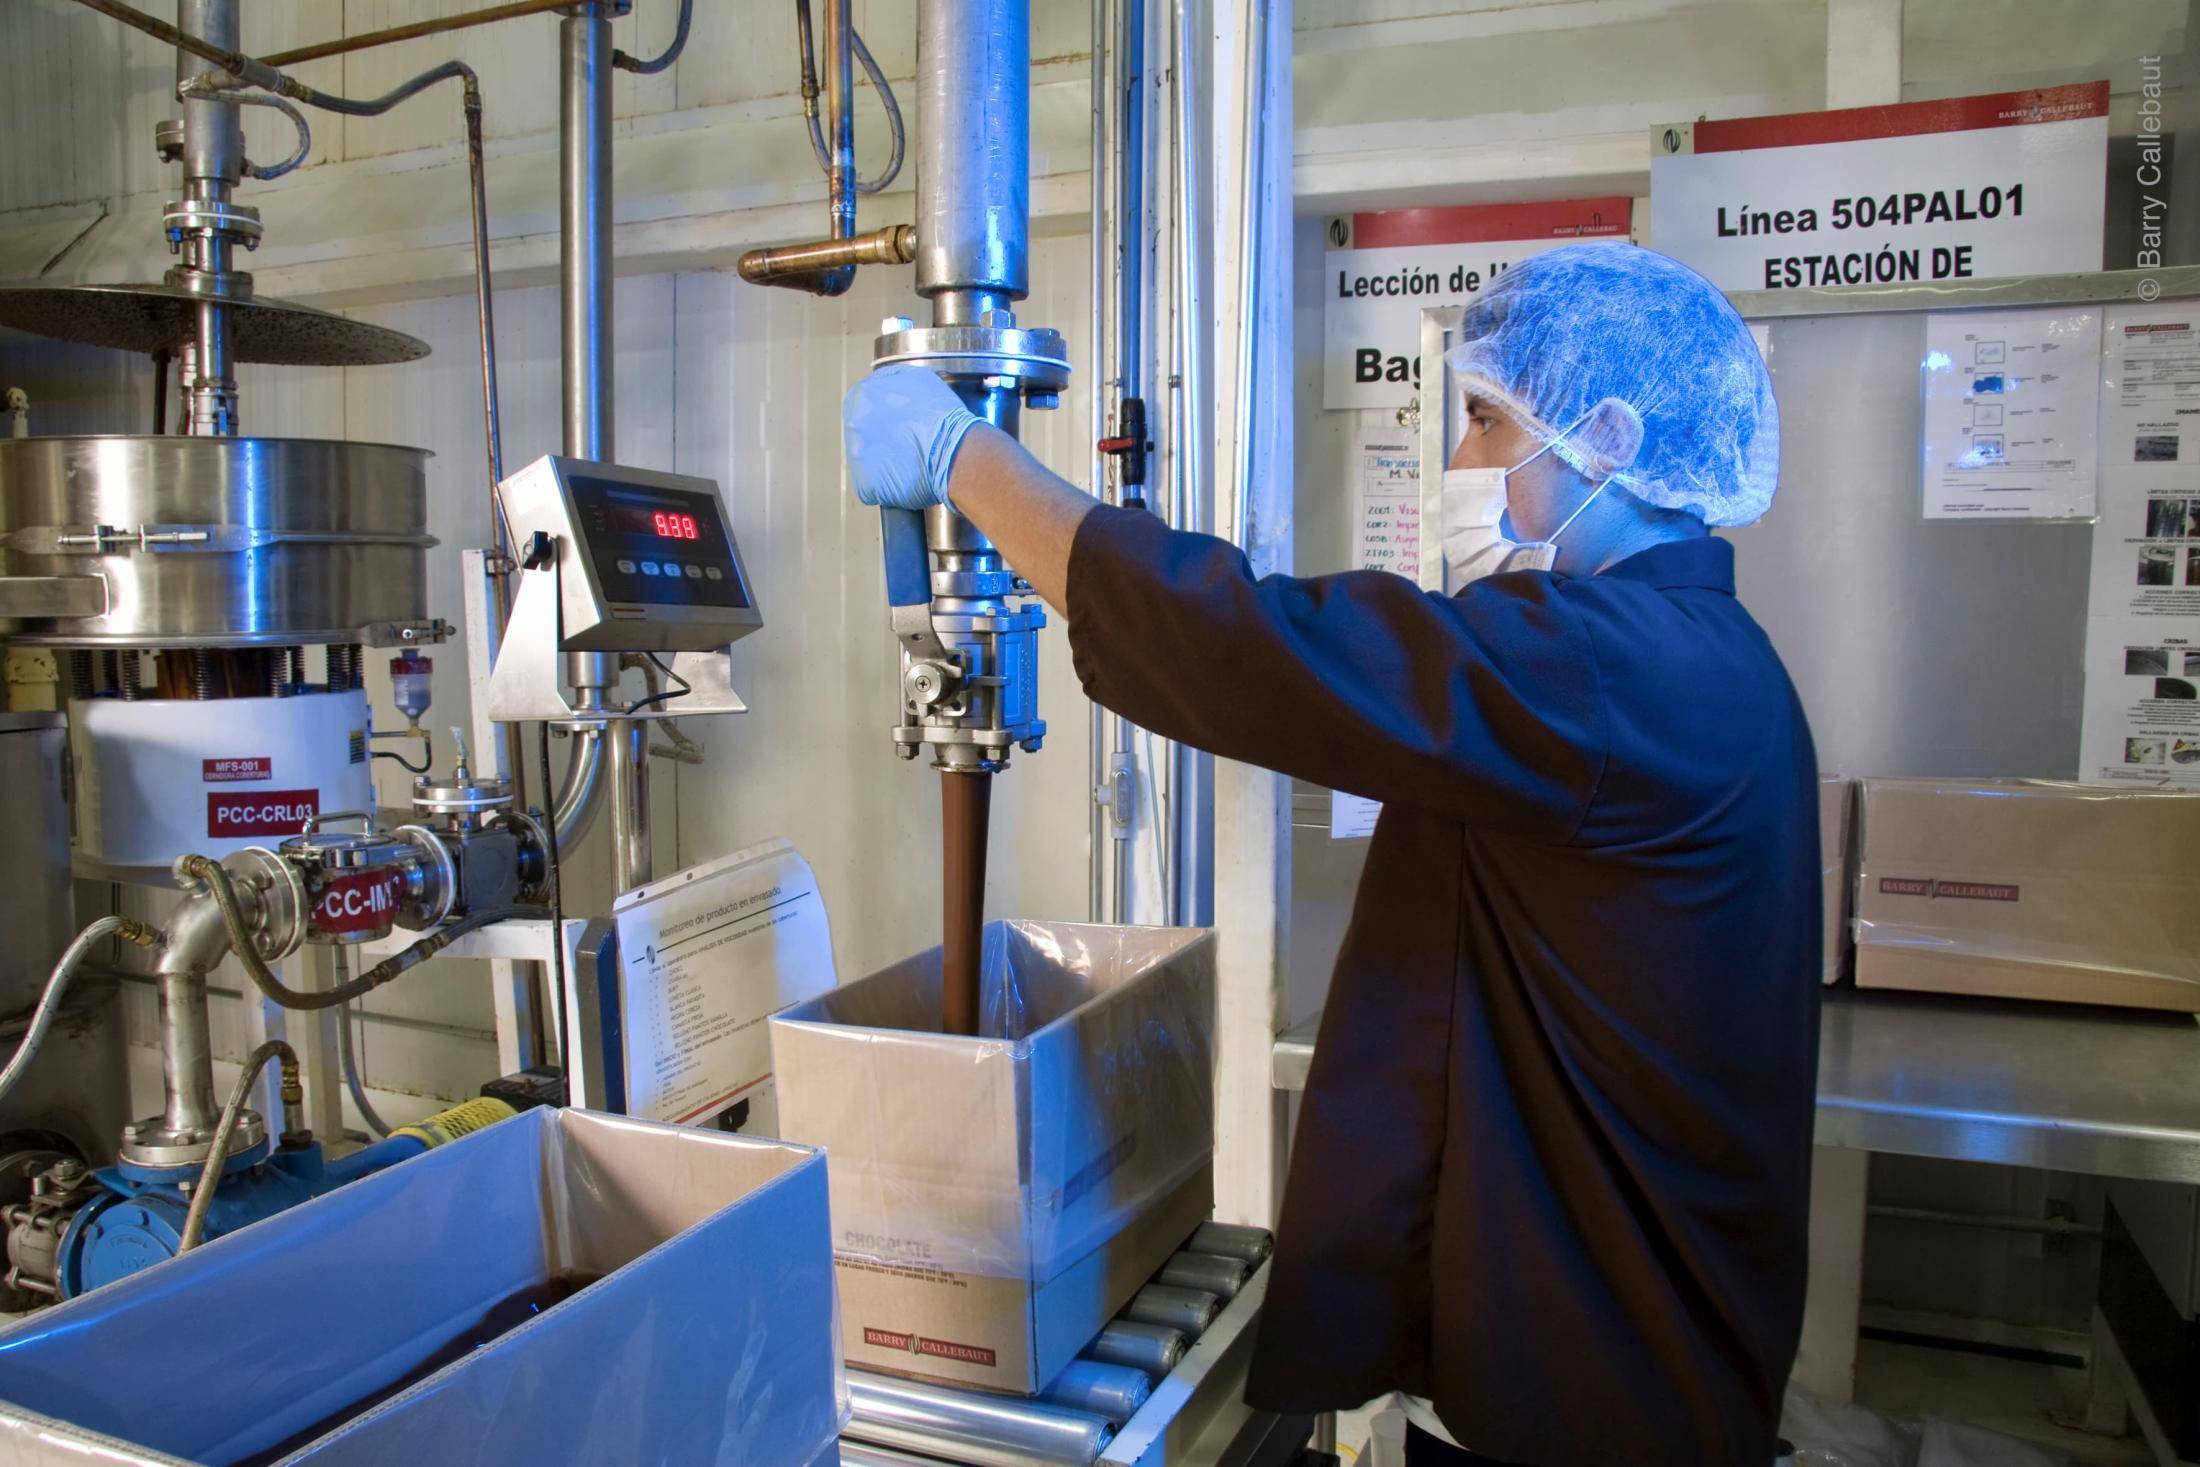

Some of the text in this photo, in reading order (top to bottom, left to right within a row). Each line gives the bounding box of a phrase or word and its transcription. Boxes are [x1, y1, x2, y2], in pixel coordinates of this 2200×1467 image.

[1998, 109, 2028, 119] BARRY
[1717, 183, 2023, 237] Línea 504PAL01
[1764, 243, 1973, 289] ESTACIÓN DE
[1339, 266, 1440, 298] Lección
[1449, 265, 1480, 293] de
[215, 761, 259, 772] MFS-001
[217, 803, 313, 823] PCC-CRL03
[1882, 880, 2009, 898] BARRY CALLEBAUT
[659, 886, 782, 939] Monitoreo de producto en envasado
[867, 1331, 990, 1361] BARRY CALLEBAUT
